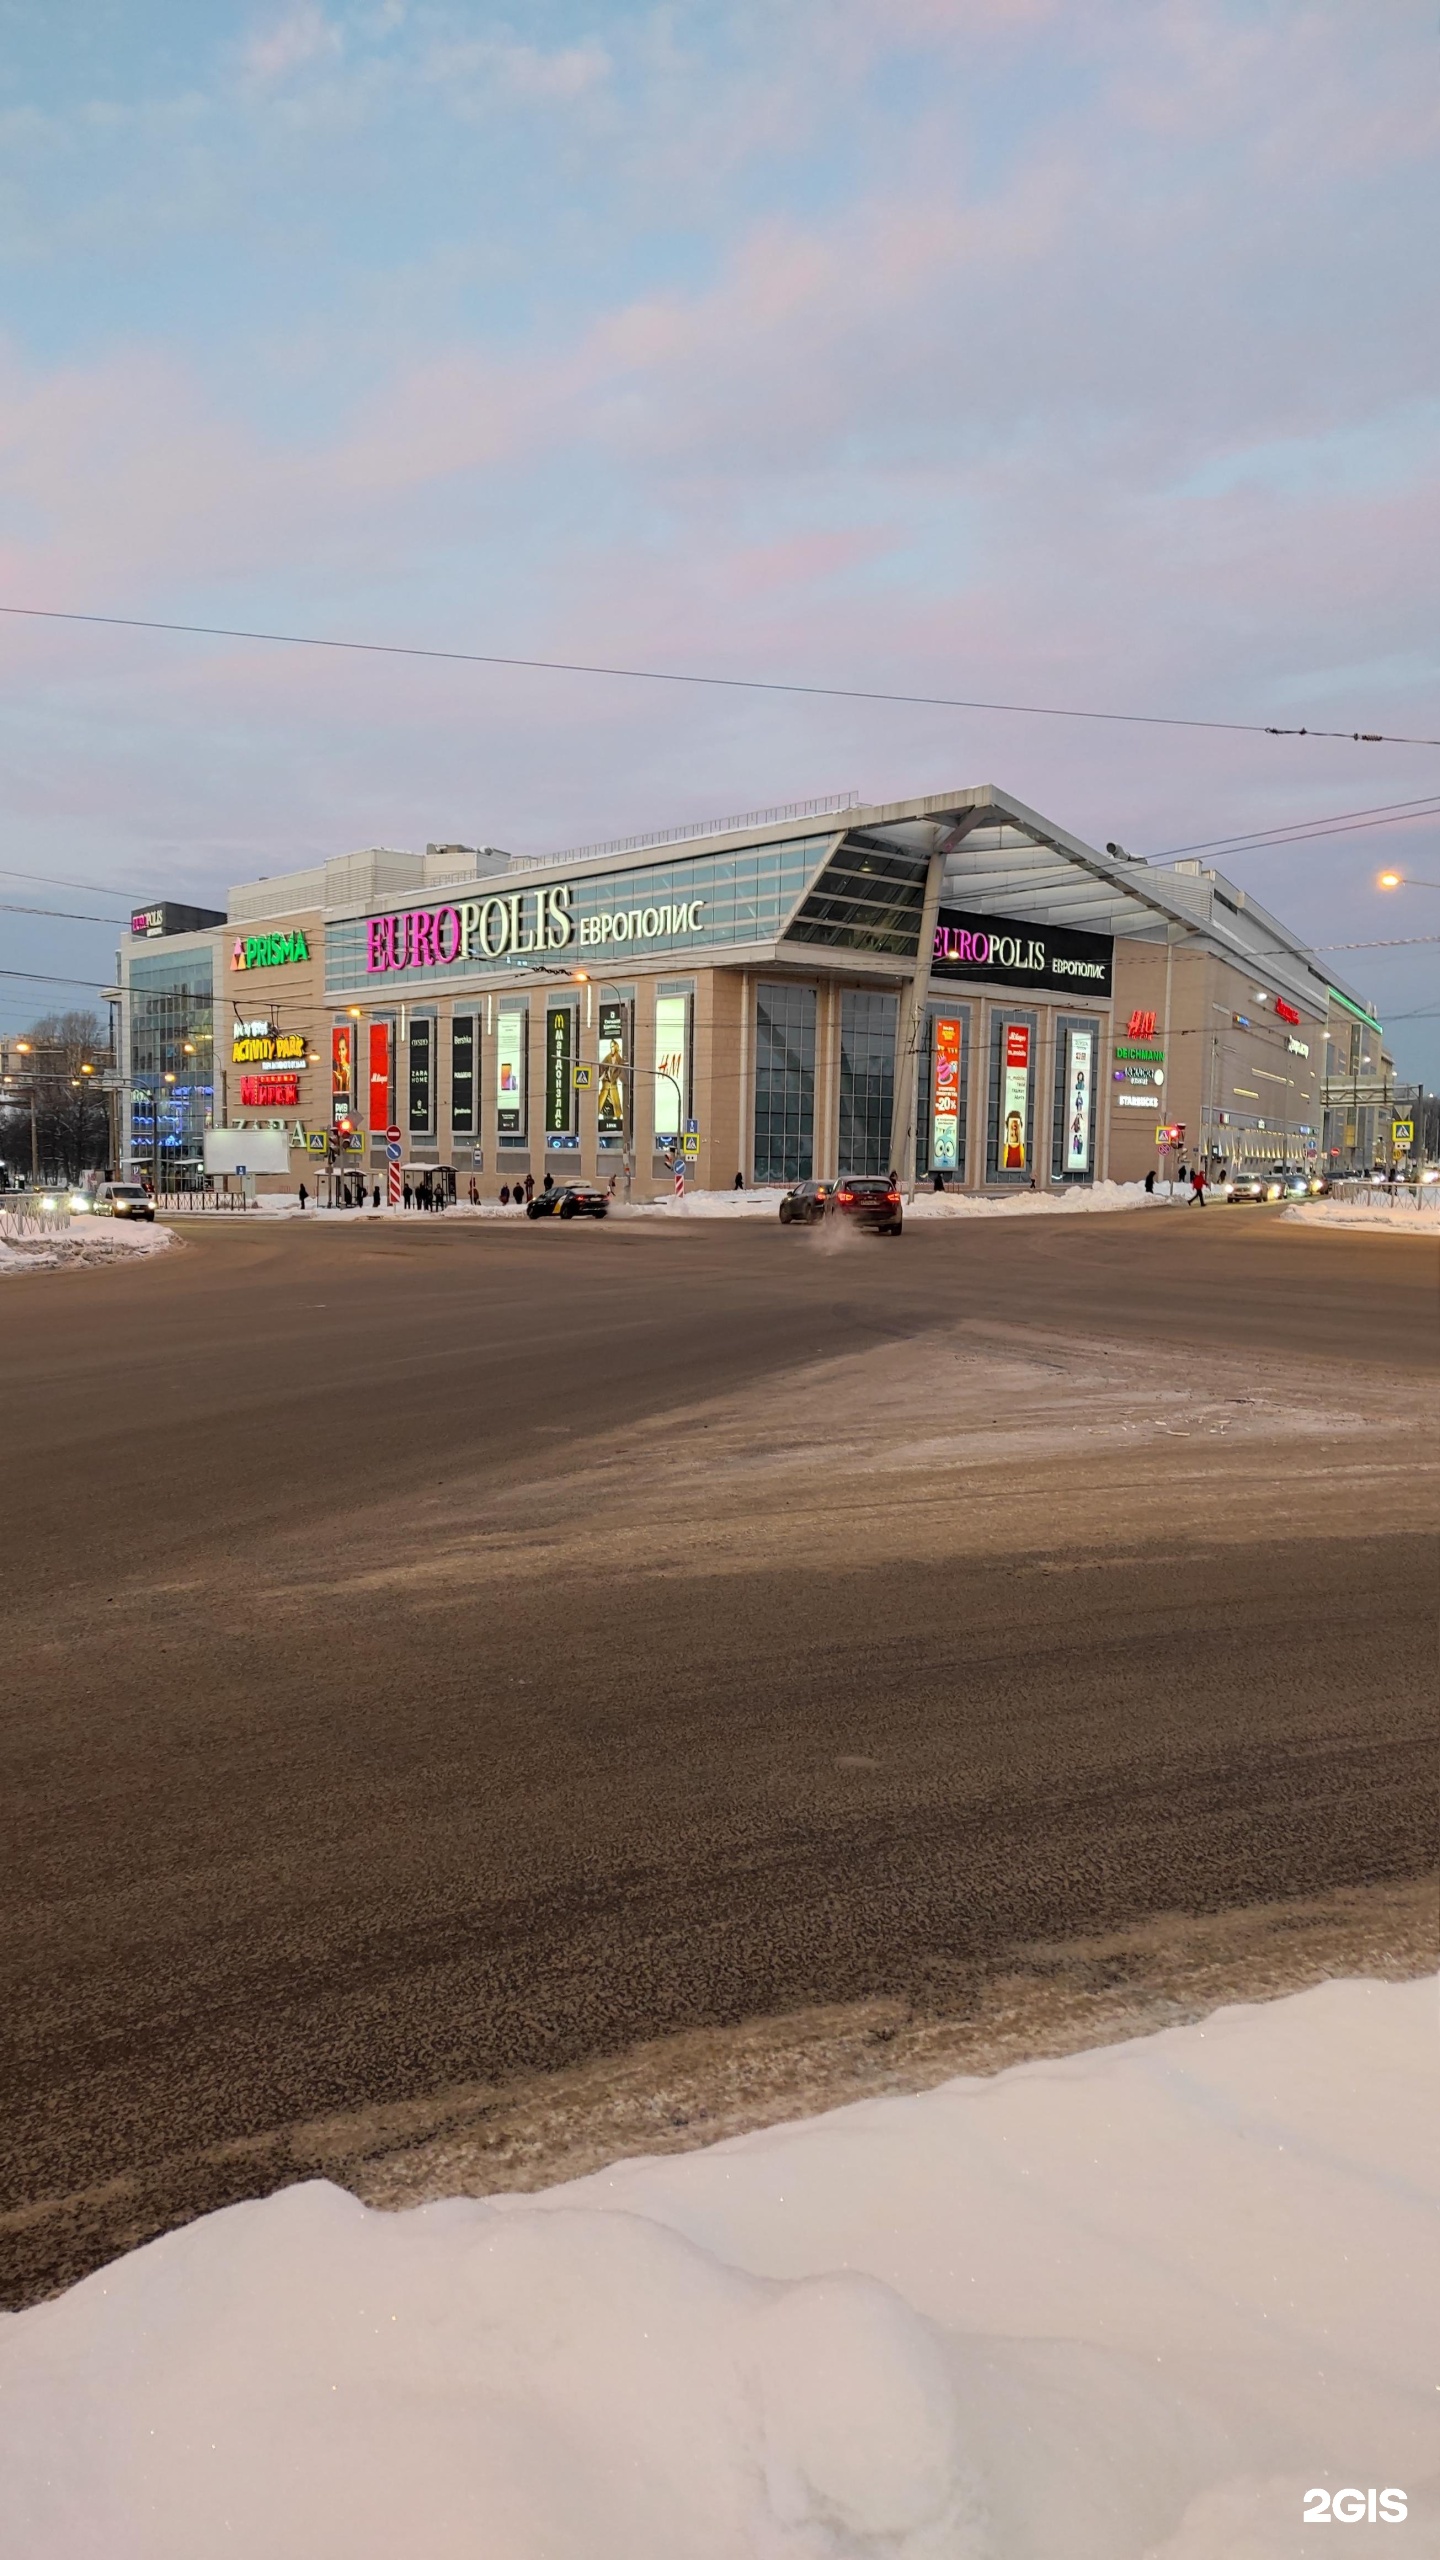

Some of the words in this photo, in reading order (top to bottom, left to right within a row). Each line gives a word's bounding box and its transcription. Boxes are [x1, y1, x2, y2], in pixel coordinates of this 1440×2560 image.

[366, 884, 573, 973] EUROPOLIS
[580, 900, 704, 946] ЕВРОПОЛИС
[246, 930, 309, 968] PRISMA
[933, 926, 1045, 970] EUROPOLIS
[1052, 957, 1106, 980] ЕВРОПОЛИС
[232, 1038, 275, 1062] ACTIVITY
[454, 1035, 472, 1045] Bershka
[1116, 1047, 1165, 1061] DEICHMANN
[935, 1096, 957, 1111] -20%
